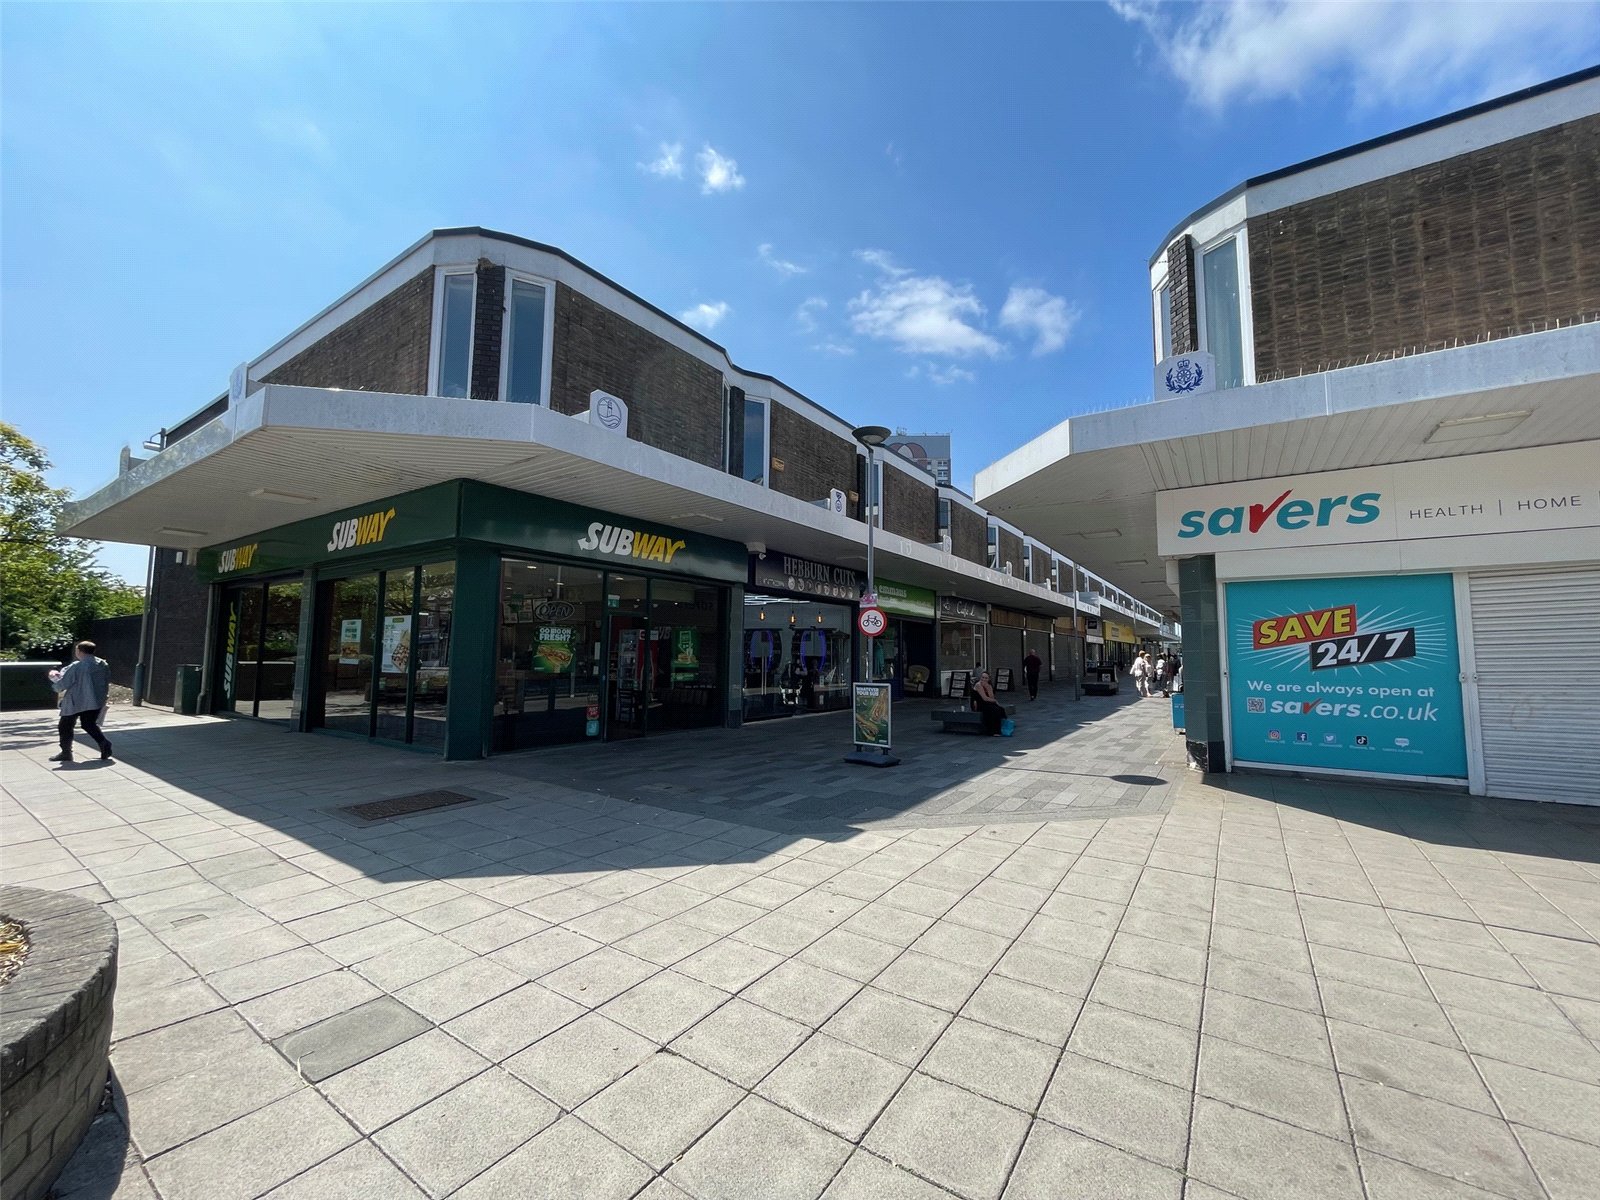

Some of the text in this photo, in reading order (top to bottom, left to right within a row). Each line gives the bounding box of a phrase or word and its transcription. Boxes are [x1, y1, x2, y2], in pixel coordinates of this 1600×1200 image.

[1177, 488, 1382, 538] savers
[1409, 495, 1582, 519] HEALTH HOME
[327, 507, 396, 552] SUBWAY
[577, 522, 685, 564] SUBWAY
[218, 543, 258, 574] SUBWAY
[783, 556, 856, 587] HEBBURN CUTS
[1258, 608, 1351, 645] SAVE
[223, 602, 238, 700] SUBWAY
[1316, 631, 1409, 667] 24/7
[1247, 680, 1435, 698] We are always open at
[1270, 698, 1439, 721] savers.co.uk
